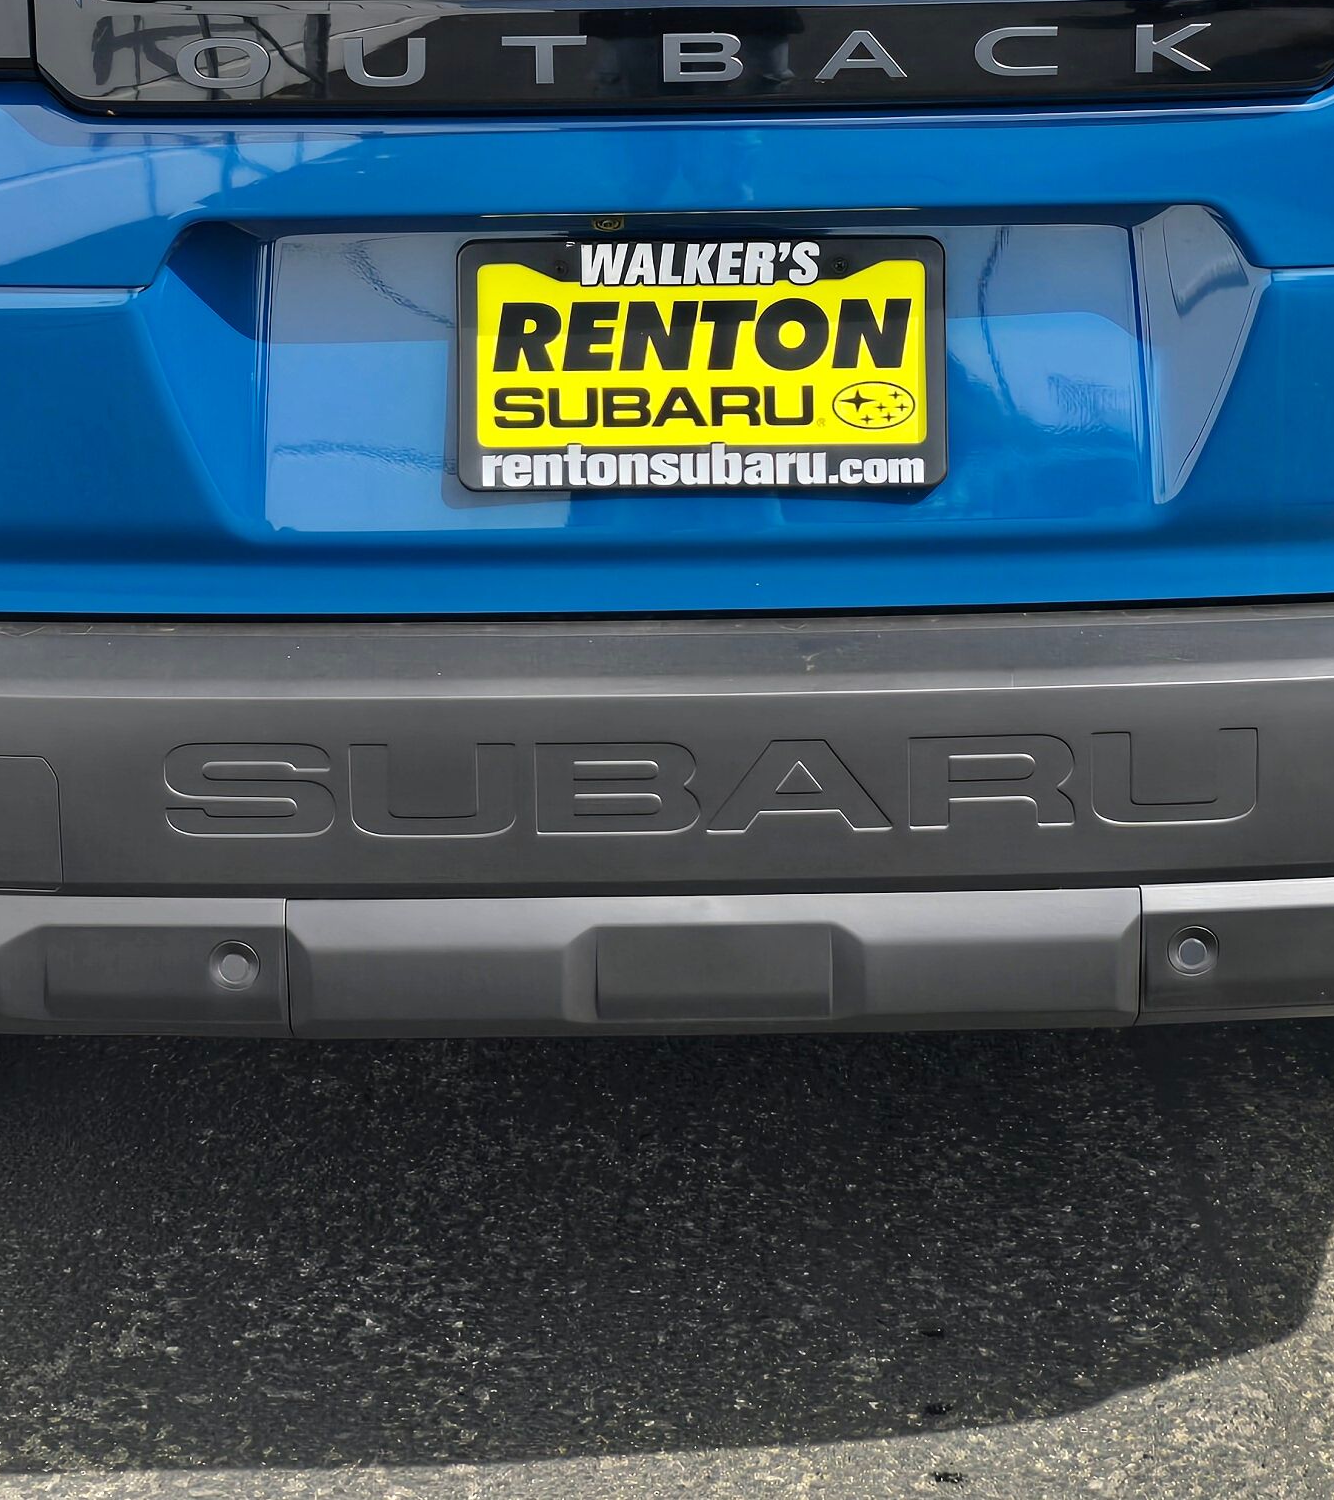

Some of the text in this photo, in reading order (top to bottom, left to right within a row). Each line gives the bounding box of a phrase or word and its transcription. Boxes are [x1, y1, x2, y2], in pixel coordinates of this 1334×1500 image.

[174, 22, 1214, 90] OUTBACK
[580, 241, 821, 287] WALKER'S
[492, 297, 913, 372] RENTON
[492, 384, 815, 429] SUBARU
[480, 442, 926, 488] rentonsubaru.com
[162, 726, 1260, 838] SUBARU
